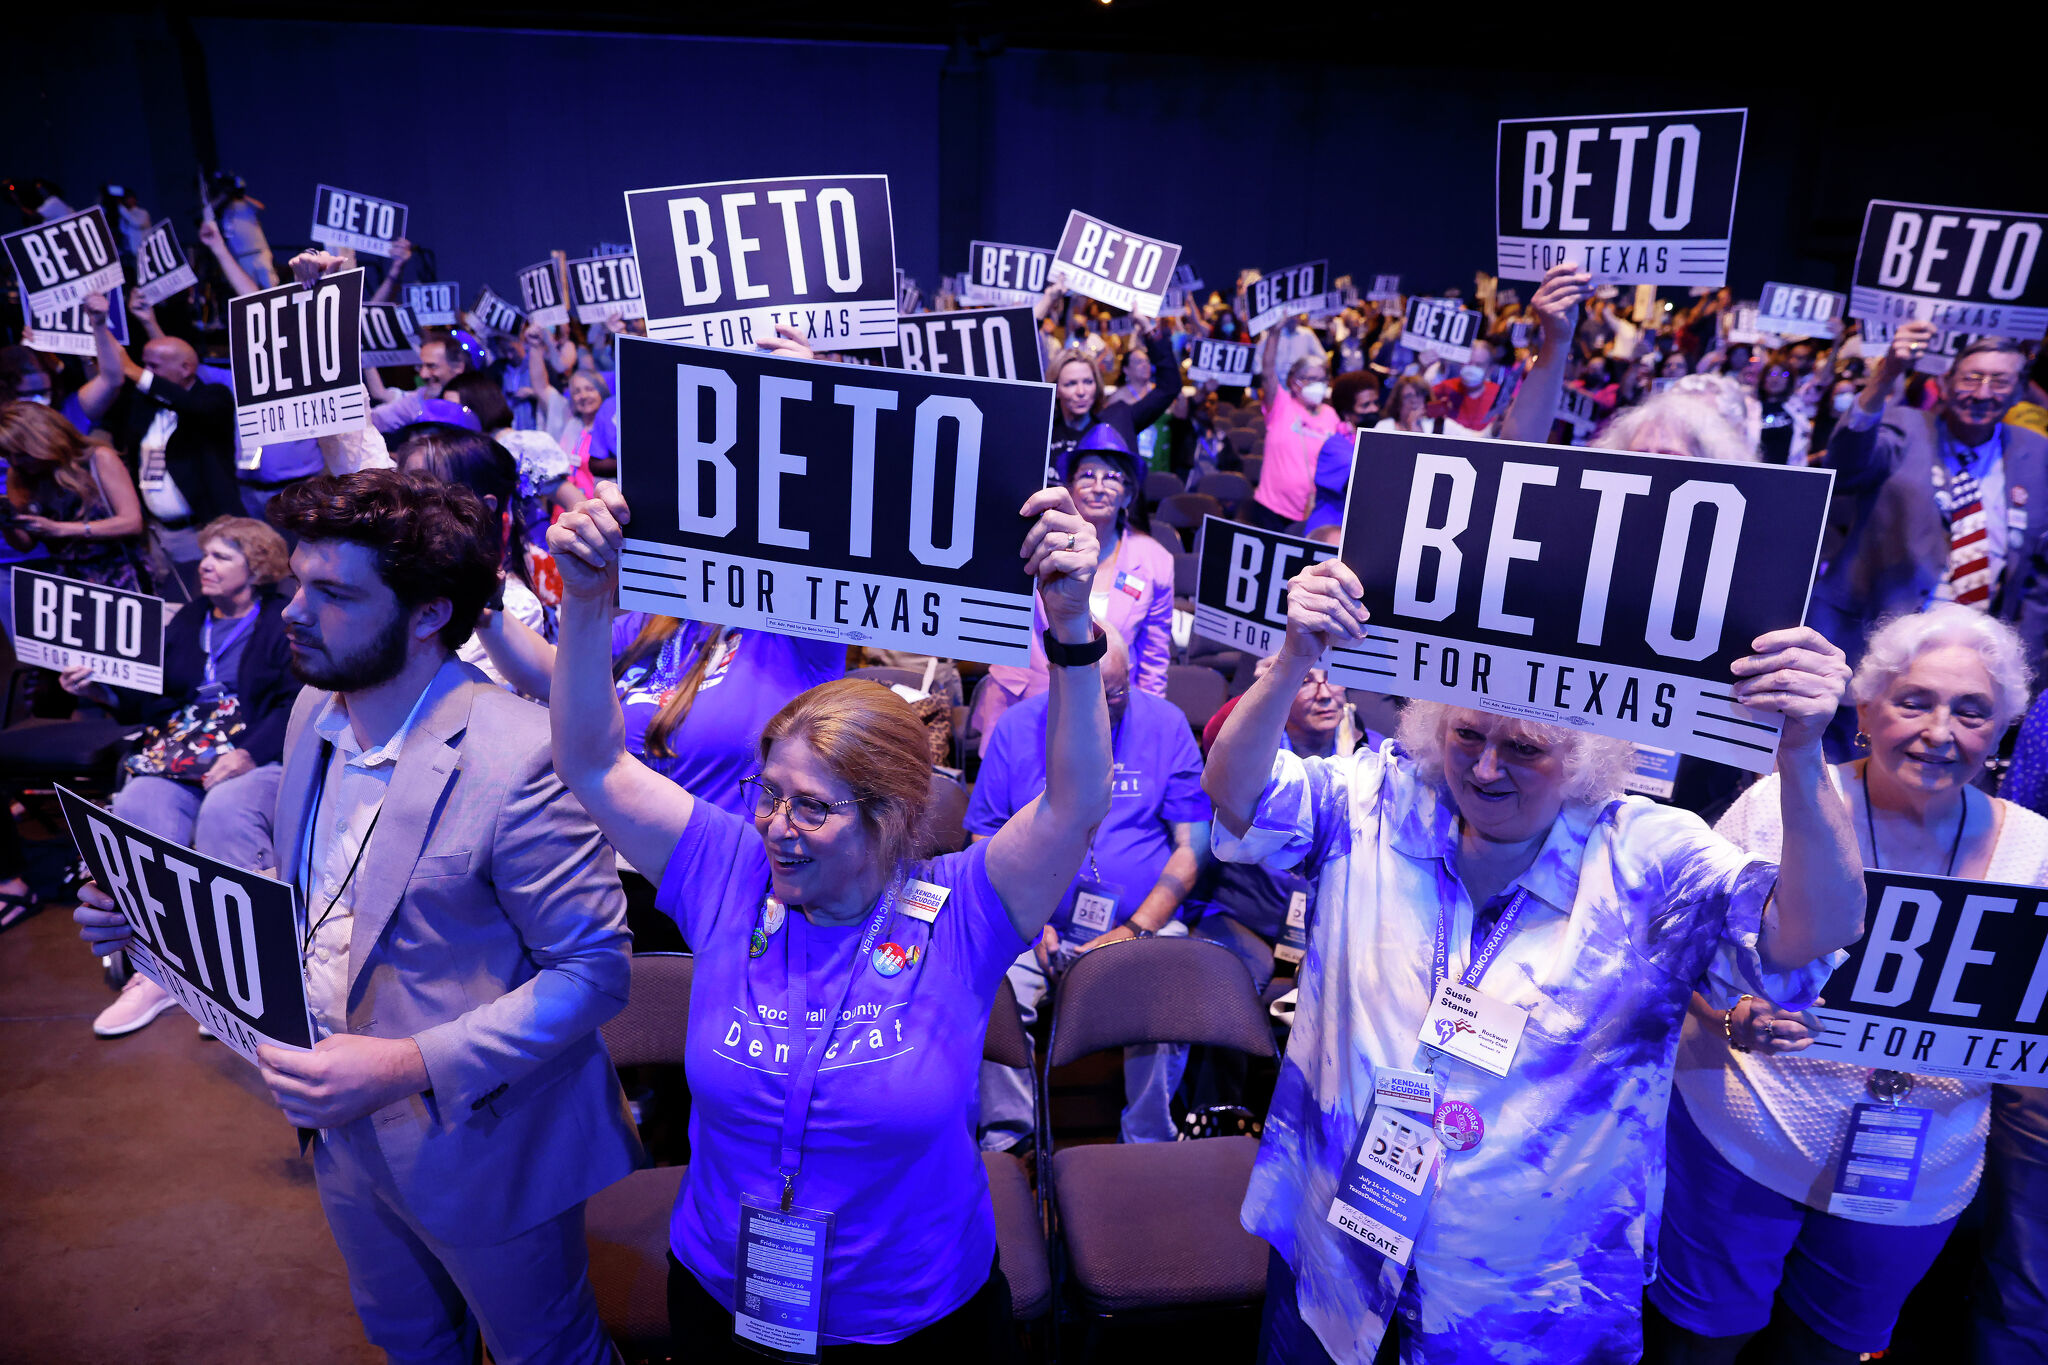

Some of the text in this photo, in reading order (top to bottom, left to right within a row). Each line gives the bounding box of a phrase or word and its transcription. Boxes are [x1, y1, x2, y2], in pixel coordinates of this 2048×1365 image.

[1521, 124, 1701, 231] BETO
[327, 192, 396, 241] BETO
[21, 215, 109, 287] BETO
[668, 188, 863, 306] BETO
[1072, 220, 1163, 290] BETO
[1532, 244, 1668, 274] FOR TEXAS
[1878, 211, 2043, 300] BETO
[576, 257, 641, 303] BETO
[981, 246, 1046, 292] BETO
[53, 285, 79, 304] FOR
[409, 285, 451, 314] BETO
[1255, 266, 1316, 314] BETO
[1770, 286, 1835, 321] BETO
[703, 309, 850, 347] FOR TEXAS
[1413, 302, 1470, 345] BETO
[1884, 296, 2002, 328] FOR TEXAS
[246, 284, 341, 397] BETO
[899, 316, 1017, 380] BETO
[1199, 342, 1248, 373] BETO
[260, 396, 338, 434] FOR TEXAS
[676, 363, 983, 569] BETO
[1393, 452, 1747, 662] BETO
[702, 560, 940, 637] FOR TEXAS
[1225, 532, 1339, 625] BE
[33, 578, 143, 658] BETO
[1233, 620, 1271, 651] FOR
[43, 646, 130, 680] FOR TEXAS
[1413, 641, 1676, 729] FOR TEXAS
[911, 894, 940, 907] SCUDDER
[915, 888, 942, 902] KENDALL
[86, 813, 265, 1020] BETO
[863, 915, 885, 954] WOMEN
[1466, 922, 1509, 985] DEMOCRATIC
[151, 955, 191, 1007] FOR
[1445, 987, 1472, 1004] Susie
[757, 1004, 826, 1022] Rocall
[723, 1019, 903, 1063] Demcrat
[1858, 1023, 2048, 1074] FOR TEX
[1391, 1077, 1430, 1090] KENDALL
[1391, 1084, 1430, 1097] SCUDDER
[1451, 1103, 1463, 1112] MY
[1462, 1107, 1479, 1131] PURSE
[1368, 1153, 1417, 1183] CONVENTION
[1349, 1184, 1407, 1221] TexasDemocrats.org
[1358, 1174, 1371, 1185] July
[1391, 1192, 1407, 1204] 2022
[1382, 1194, 1399, 1208] Texas
[758, 1213, 787, 1225] Thursdy,
[1338, 1215, 1399, 1256] DELEGATE
